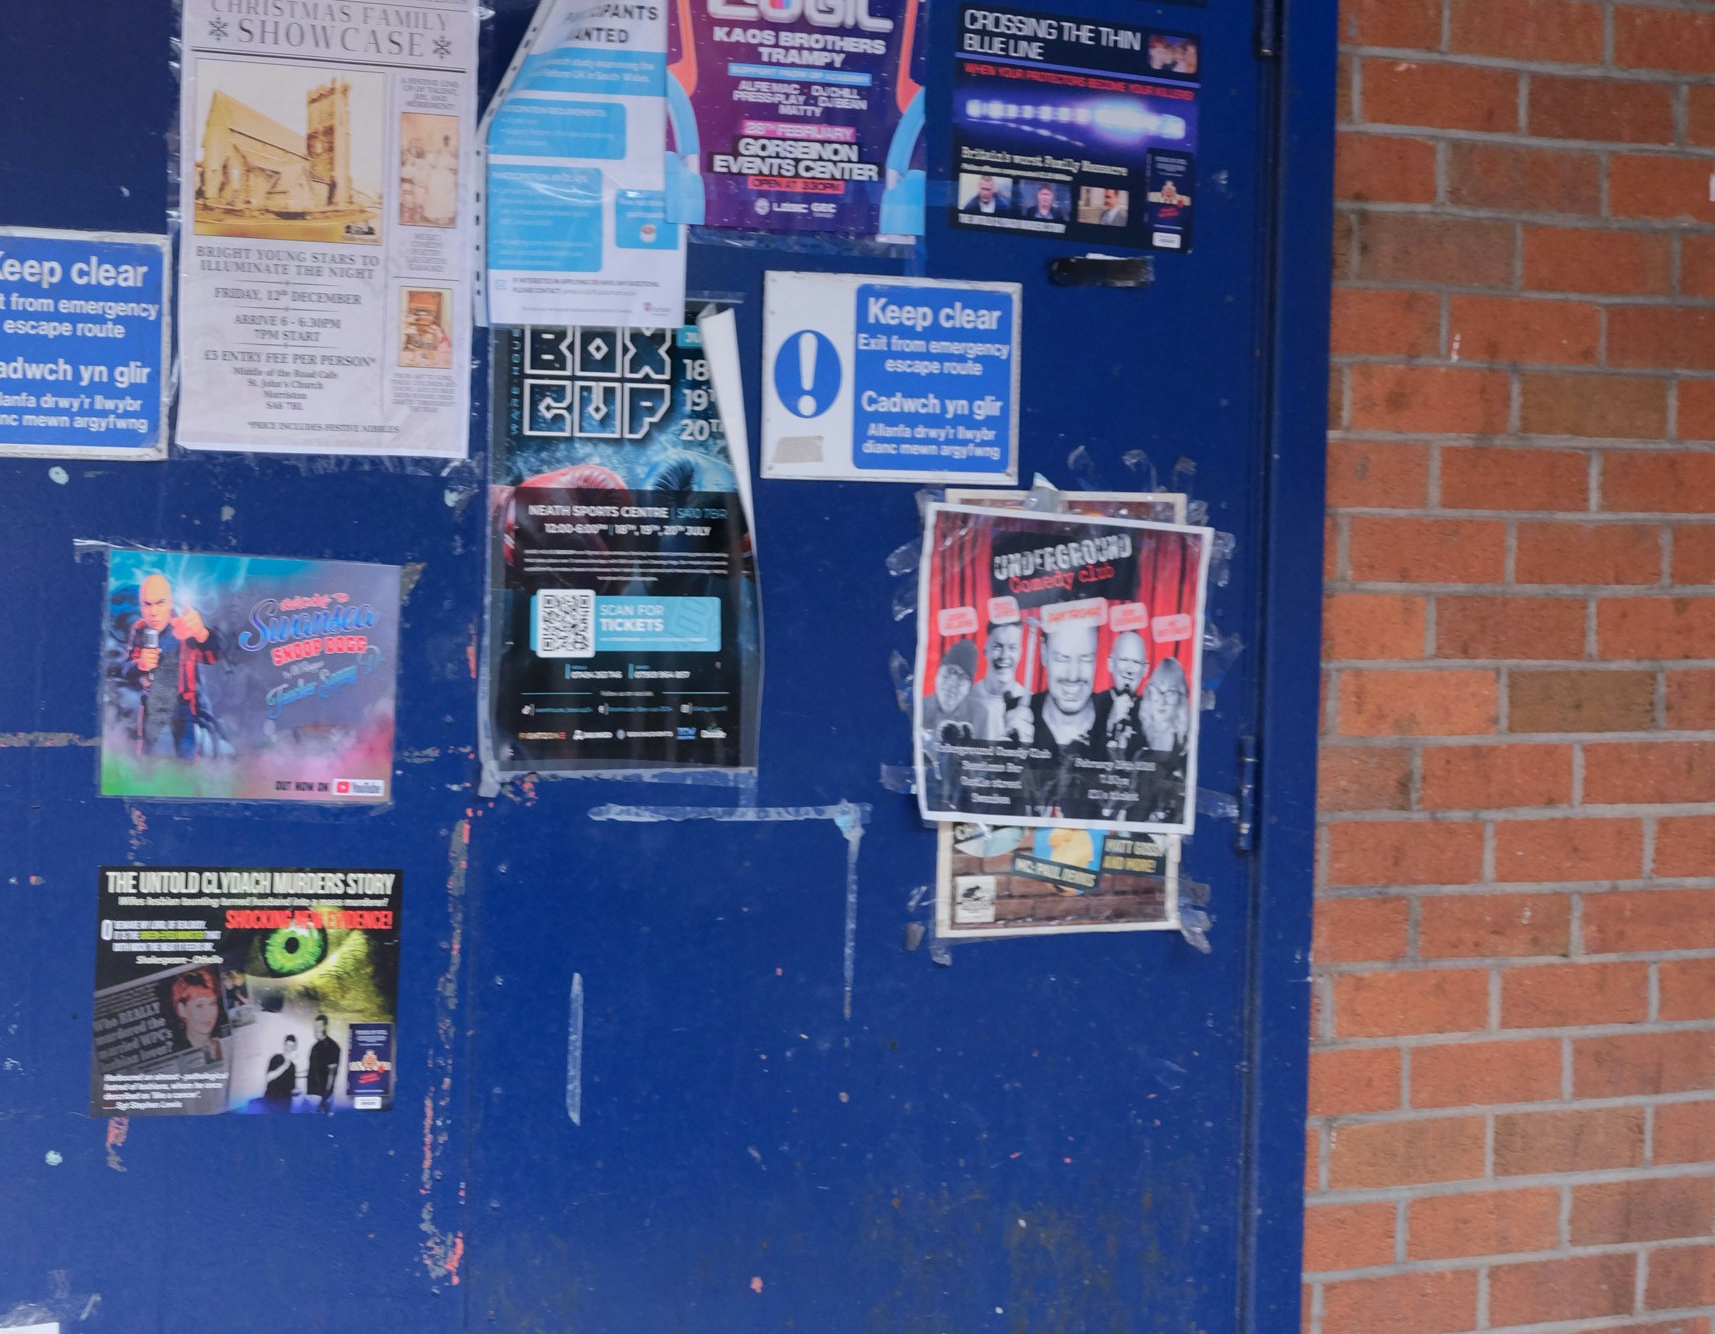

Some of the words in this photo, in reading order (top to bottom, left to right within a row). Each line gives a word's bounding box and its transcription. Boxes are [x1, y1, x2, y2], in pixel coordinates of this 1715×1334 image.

[363, 7, 449, 31] FAMILY
[964, 9, 1058, 40] CROSSING
[1060, 22, 1096, 44] THE
[1097, 27, 1141, 50] THIN
[237, 18, 425, 57] SHOWCASE
[713, 26, 776, 44] KAOS
[779, 32, 886, 54] BROTHERS
[963, 33, 1008, 55] BLUE
[1009, 41, 1044, 60] LINE
[758, 47, 846, 68] TRAMPY
[777, 123, 855, 142] FEBRUARY
[738, 138, 859, 162] GORSEINON
[712, 155, 797, 176] EVENTS
[798, 159, 878, 181] CENTER
[197, 246, 253, 260] BRIGHT
[257, 249, 307, 263] YOUNG
[311, 252, 357, 265] STARS
[360, 254, 380, 267] TO
[70, 256, 148, 287] clear
[200, 259, 290, 275] ILLUMINATE
[294, 264, 325, 277] THE
[328, 267, 375, 280] NIGHT
[10, 292, 54, 313] from
[58, 298, 160, 321] emergency
[213, 287, 262, 301] FRIDAY,
[291, 291, 362, 305] DECEMBER
[867, 297, 933, 332] Keep
[939, 302, 1002, 330] clear
[3, 320, 72, 339] escape
[76, 322, 126, 339] route
[221, 351, 262, 363] ENTRY
[265, 352, 289, 364] FEE
[292, 354, 317, 365] PER
[857, 333, 888, 351] Exit
[890, 336, 927, 353] from
[929, 340, 1011, 360] emergency
[78, 365, 109, 387] yn
[113, 361, 152, 388] glir
[885, 358, 941, 377] escape
[943, 361, 984, 376] route
[40, 393, 91, 413] drwy'r
[94, 395, 143, 414] llwybr
[861, 390, 941, 414] Cadwch
[945, 399, 970, 418] yn
[972, 395, 1004, 420] glir
[22, 414, 71, 428] mewn
[73, 414, 149, 433] argyfwng
[867, 422, 912, 437] Allanfa
[957, 425, 996, 442] llwybr
[862, 440, 898, 454] dianc
[900, 443, 940, 455] mewn
[940, 443, 1001, 460] argyfwng
[528, 505, 571, 517] NEATH
[572, 506, 619, 518] SPORTS
[620, 507, 669, 519] CENTRE
[993, 533, 1133, 581] UNDERGROUND
[1009, 569, 1075, 593] Comedy
[599, 604, 632, 616] SCAN
[637, 605, 664, 617] FOR
[239, 598, 380, 652] Swansea
[599, 618, 665, 632] TICKETS
[271, 638, 322, 666] SNOOP
[325, 635, 368, 654] DOGG
[275, 781, 292, 792] OUT
[295, 781, 315, 792] NOW
[317, 782, 329, 792] ON
[351, 782, 381, 795] YouTube
[106, 871, 138, 893] THE
[139, 872, 200, 894] UNTOLD
[201, 872, 271, 895] CLYDACH
[272, 873, 345, 895] MURDERS
[345, 873, 395, 896] STORY
[225, 910, 291, 930] SHOCKING
[326, 910, 393, 930] EVIDENCE!
